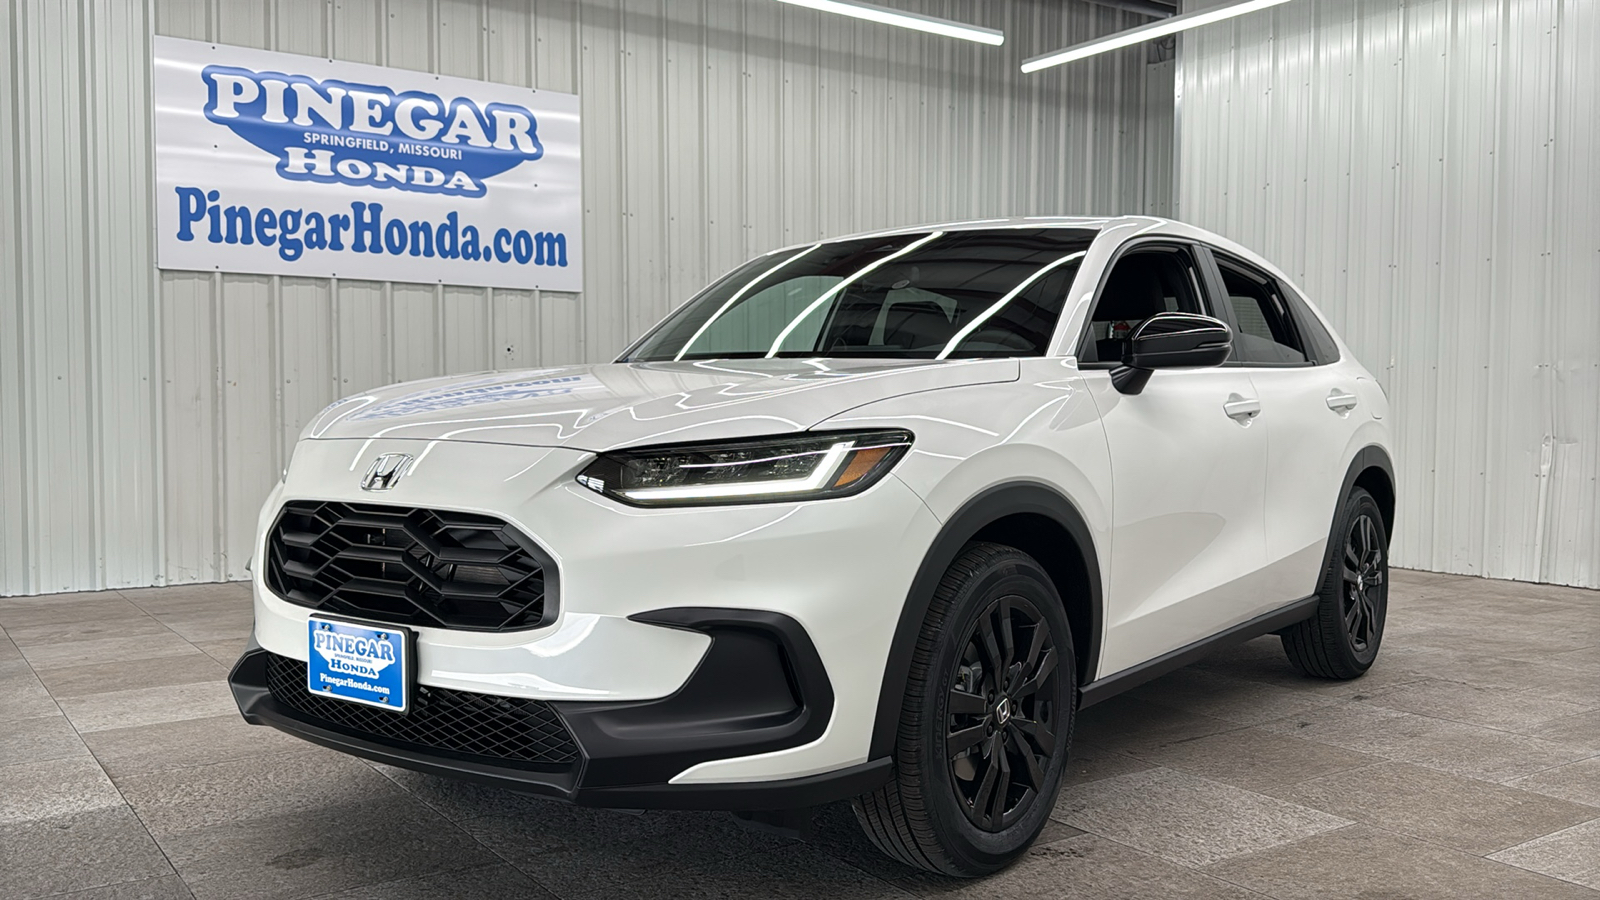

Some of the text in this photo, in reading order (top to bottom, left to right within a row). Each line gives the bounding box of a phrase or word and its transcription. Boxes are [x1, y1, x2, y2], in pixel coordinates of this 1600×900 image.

[209, 72, 538, 154] PINEGAR
[303, 131, 463, 161] SPRINGFIELD, MISSOURI
[282, 147, 481, 192] HONDA
[174, 186, 569, 267] PinegarHonda.com
[315, 632, 394, 661] PINEGAR
[330, 658, 377, 676] HONDA
[320, 673, 390, 695] PinegarHonda.com
